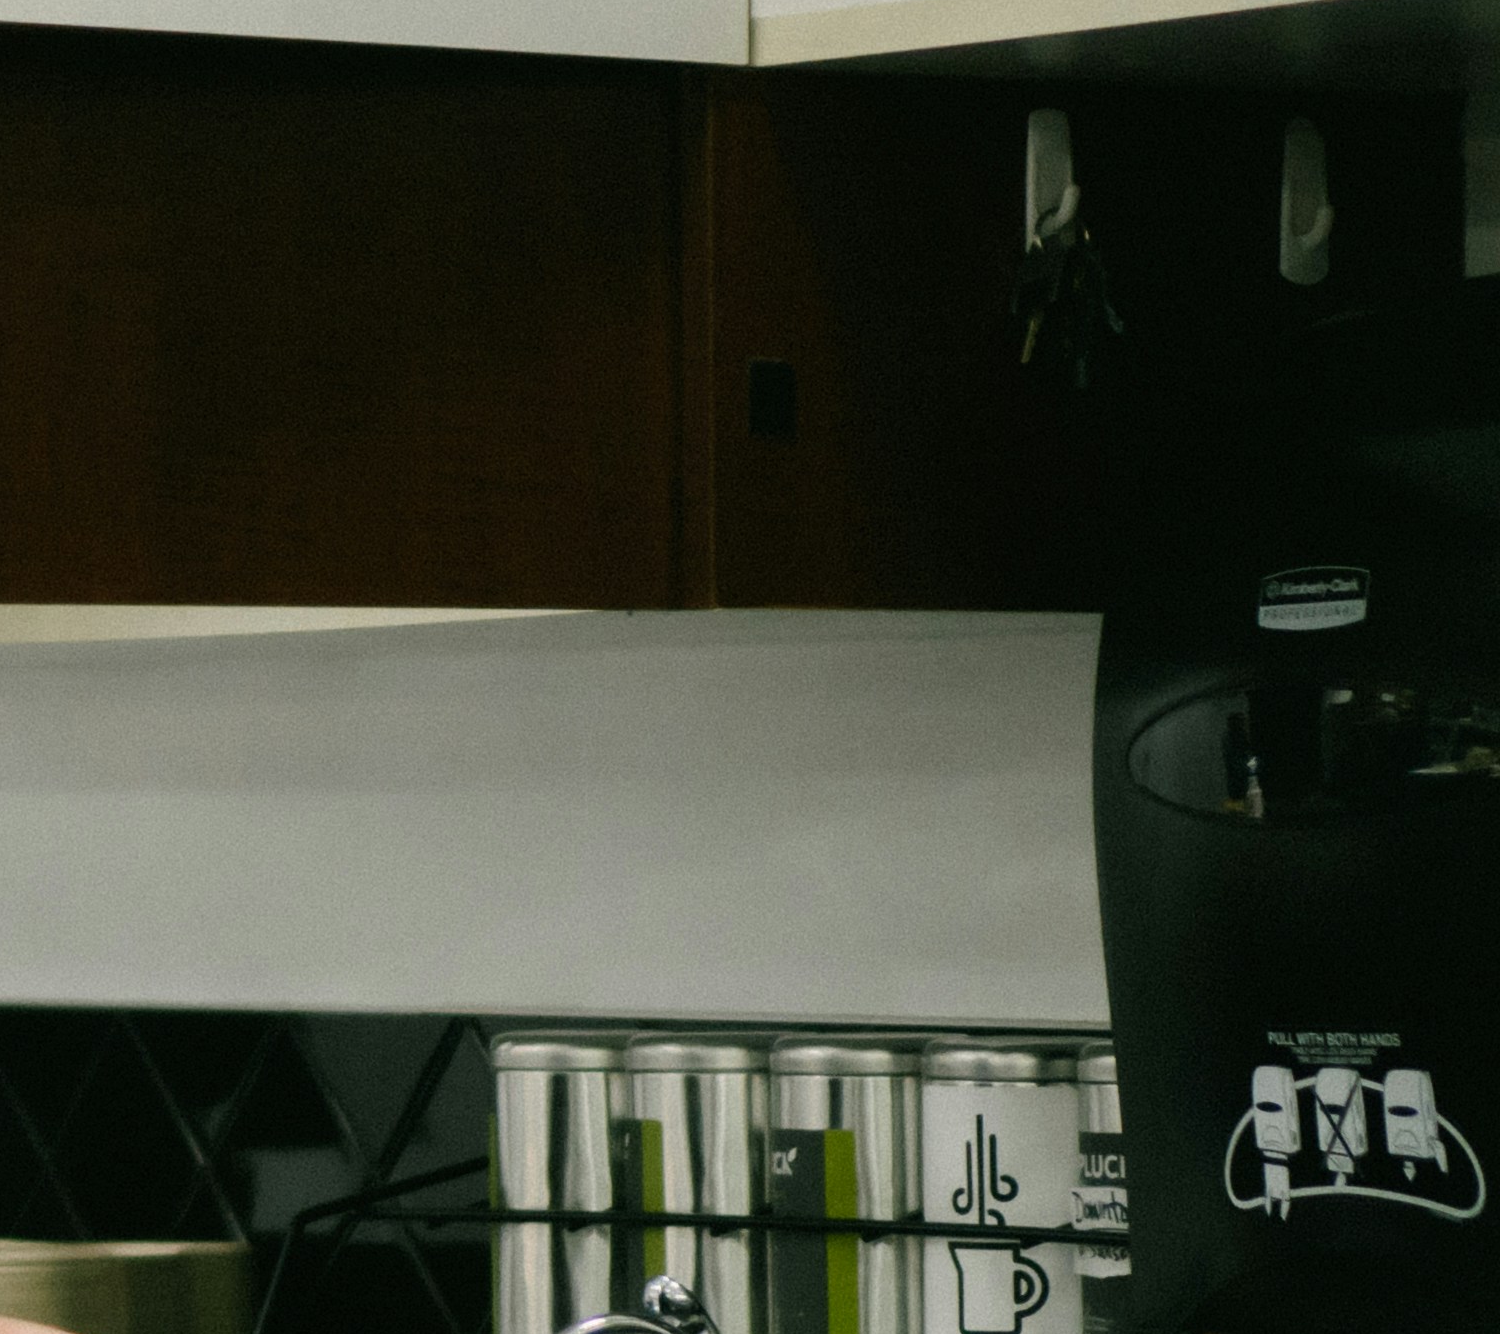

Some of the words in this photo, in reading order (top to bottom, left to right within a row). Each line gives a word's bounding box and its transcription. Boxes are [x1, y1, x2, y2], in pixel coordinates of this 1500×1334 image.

[1267, 1031, 1295, 1046] PULL
[1296, 1031, 1324, 1047] WITH
[1326, 1031, 1358, 1047] BOTH
[1359, 1032, 1401, 1047] HANDS
